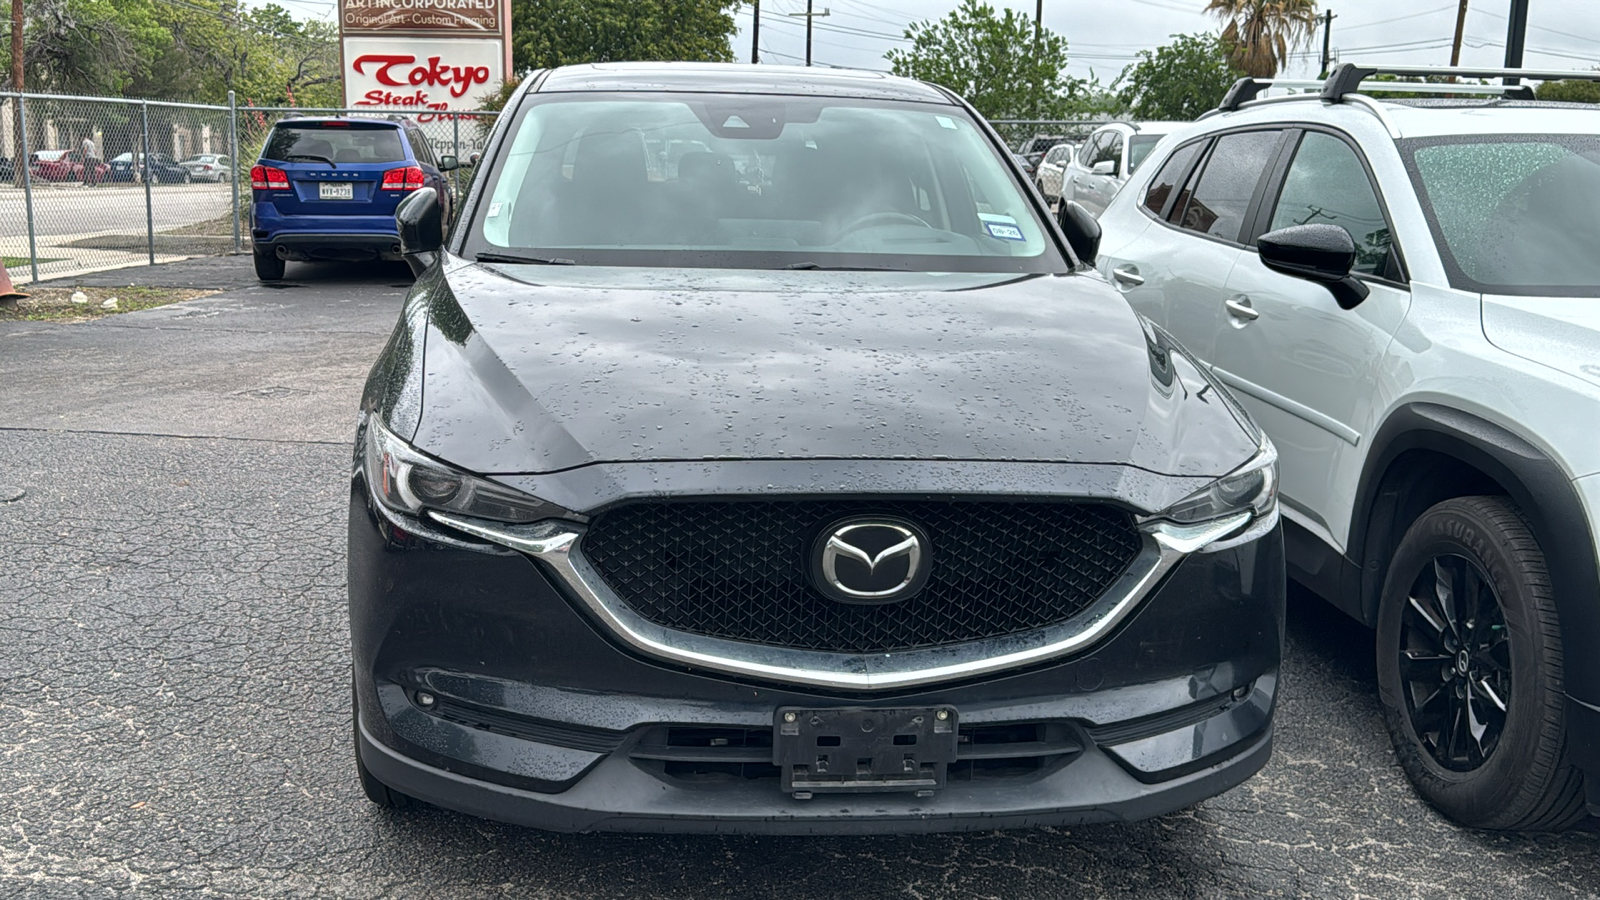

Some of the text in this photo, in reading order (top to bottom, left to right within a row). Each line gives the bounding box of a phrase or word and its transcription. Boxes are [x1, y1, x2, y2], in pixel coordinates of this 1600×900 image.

[345, 12, 496, 28] Original Art Custom Framing
[352, 54, 490, 98] Tokyo
[354, 90, 429, 106] Steak
